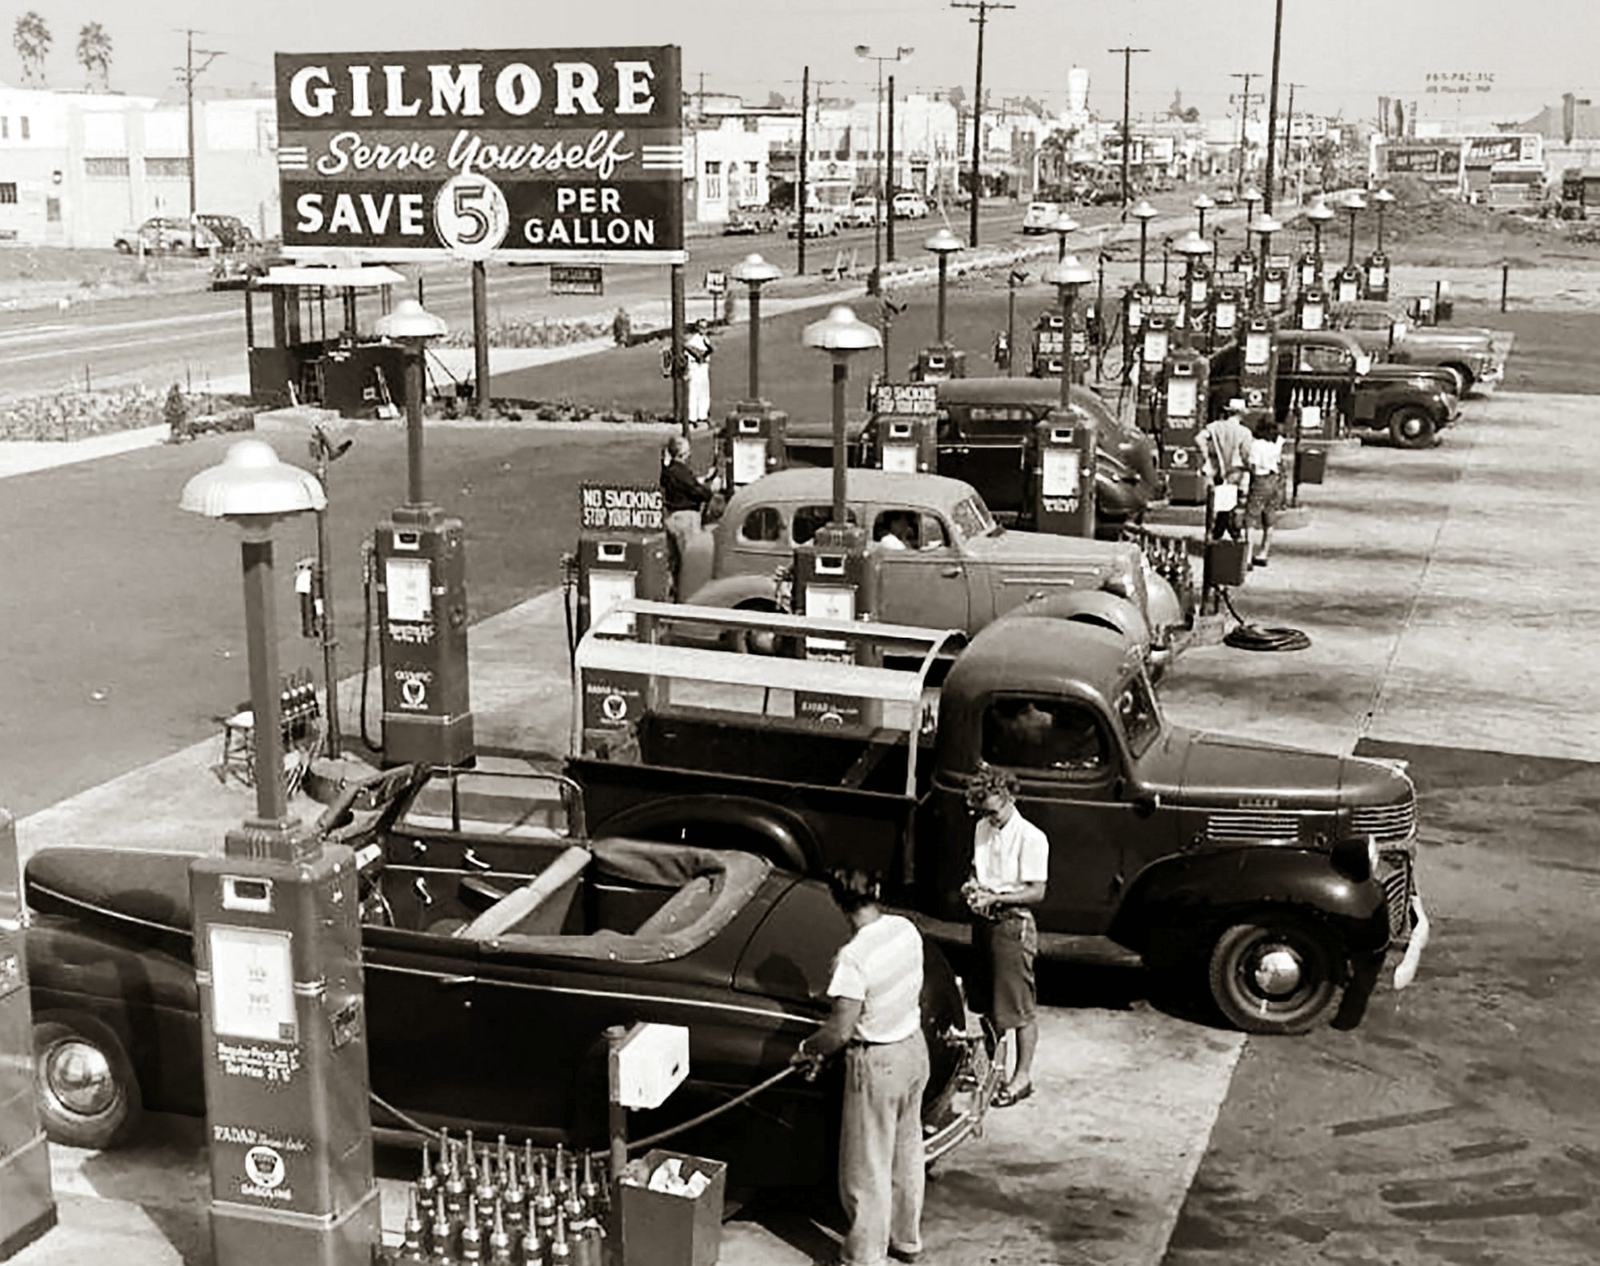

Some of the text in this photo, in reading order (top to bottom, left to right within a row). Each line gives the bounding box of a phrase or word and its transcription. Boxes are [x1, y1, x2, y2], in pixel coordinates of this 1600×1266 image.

[290, 61, 655, 117] GILMORE
[317, 129, 634, 180] Serve Yourself
[296, 192, 424, 235] SAVE
[556, 187, 622, 213] PER
[524, 218, 654, 245] GALLON
[583, 488, 602, 507] NO
